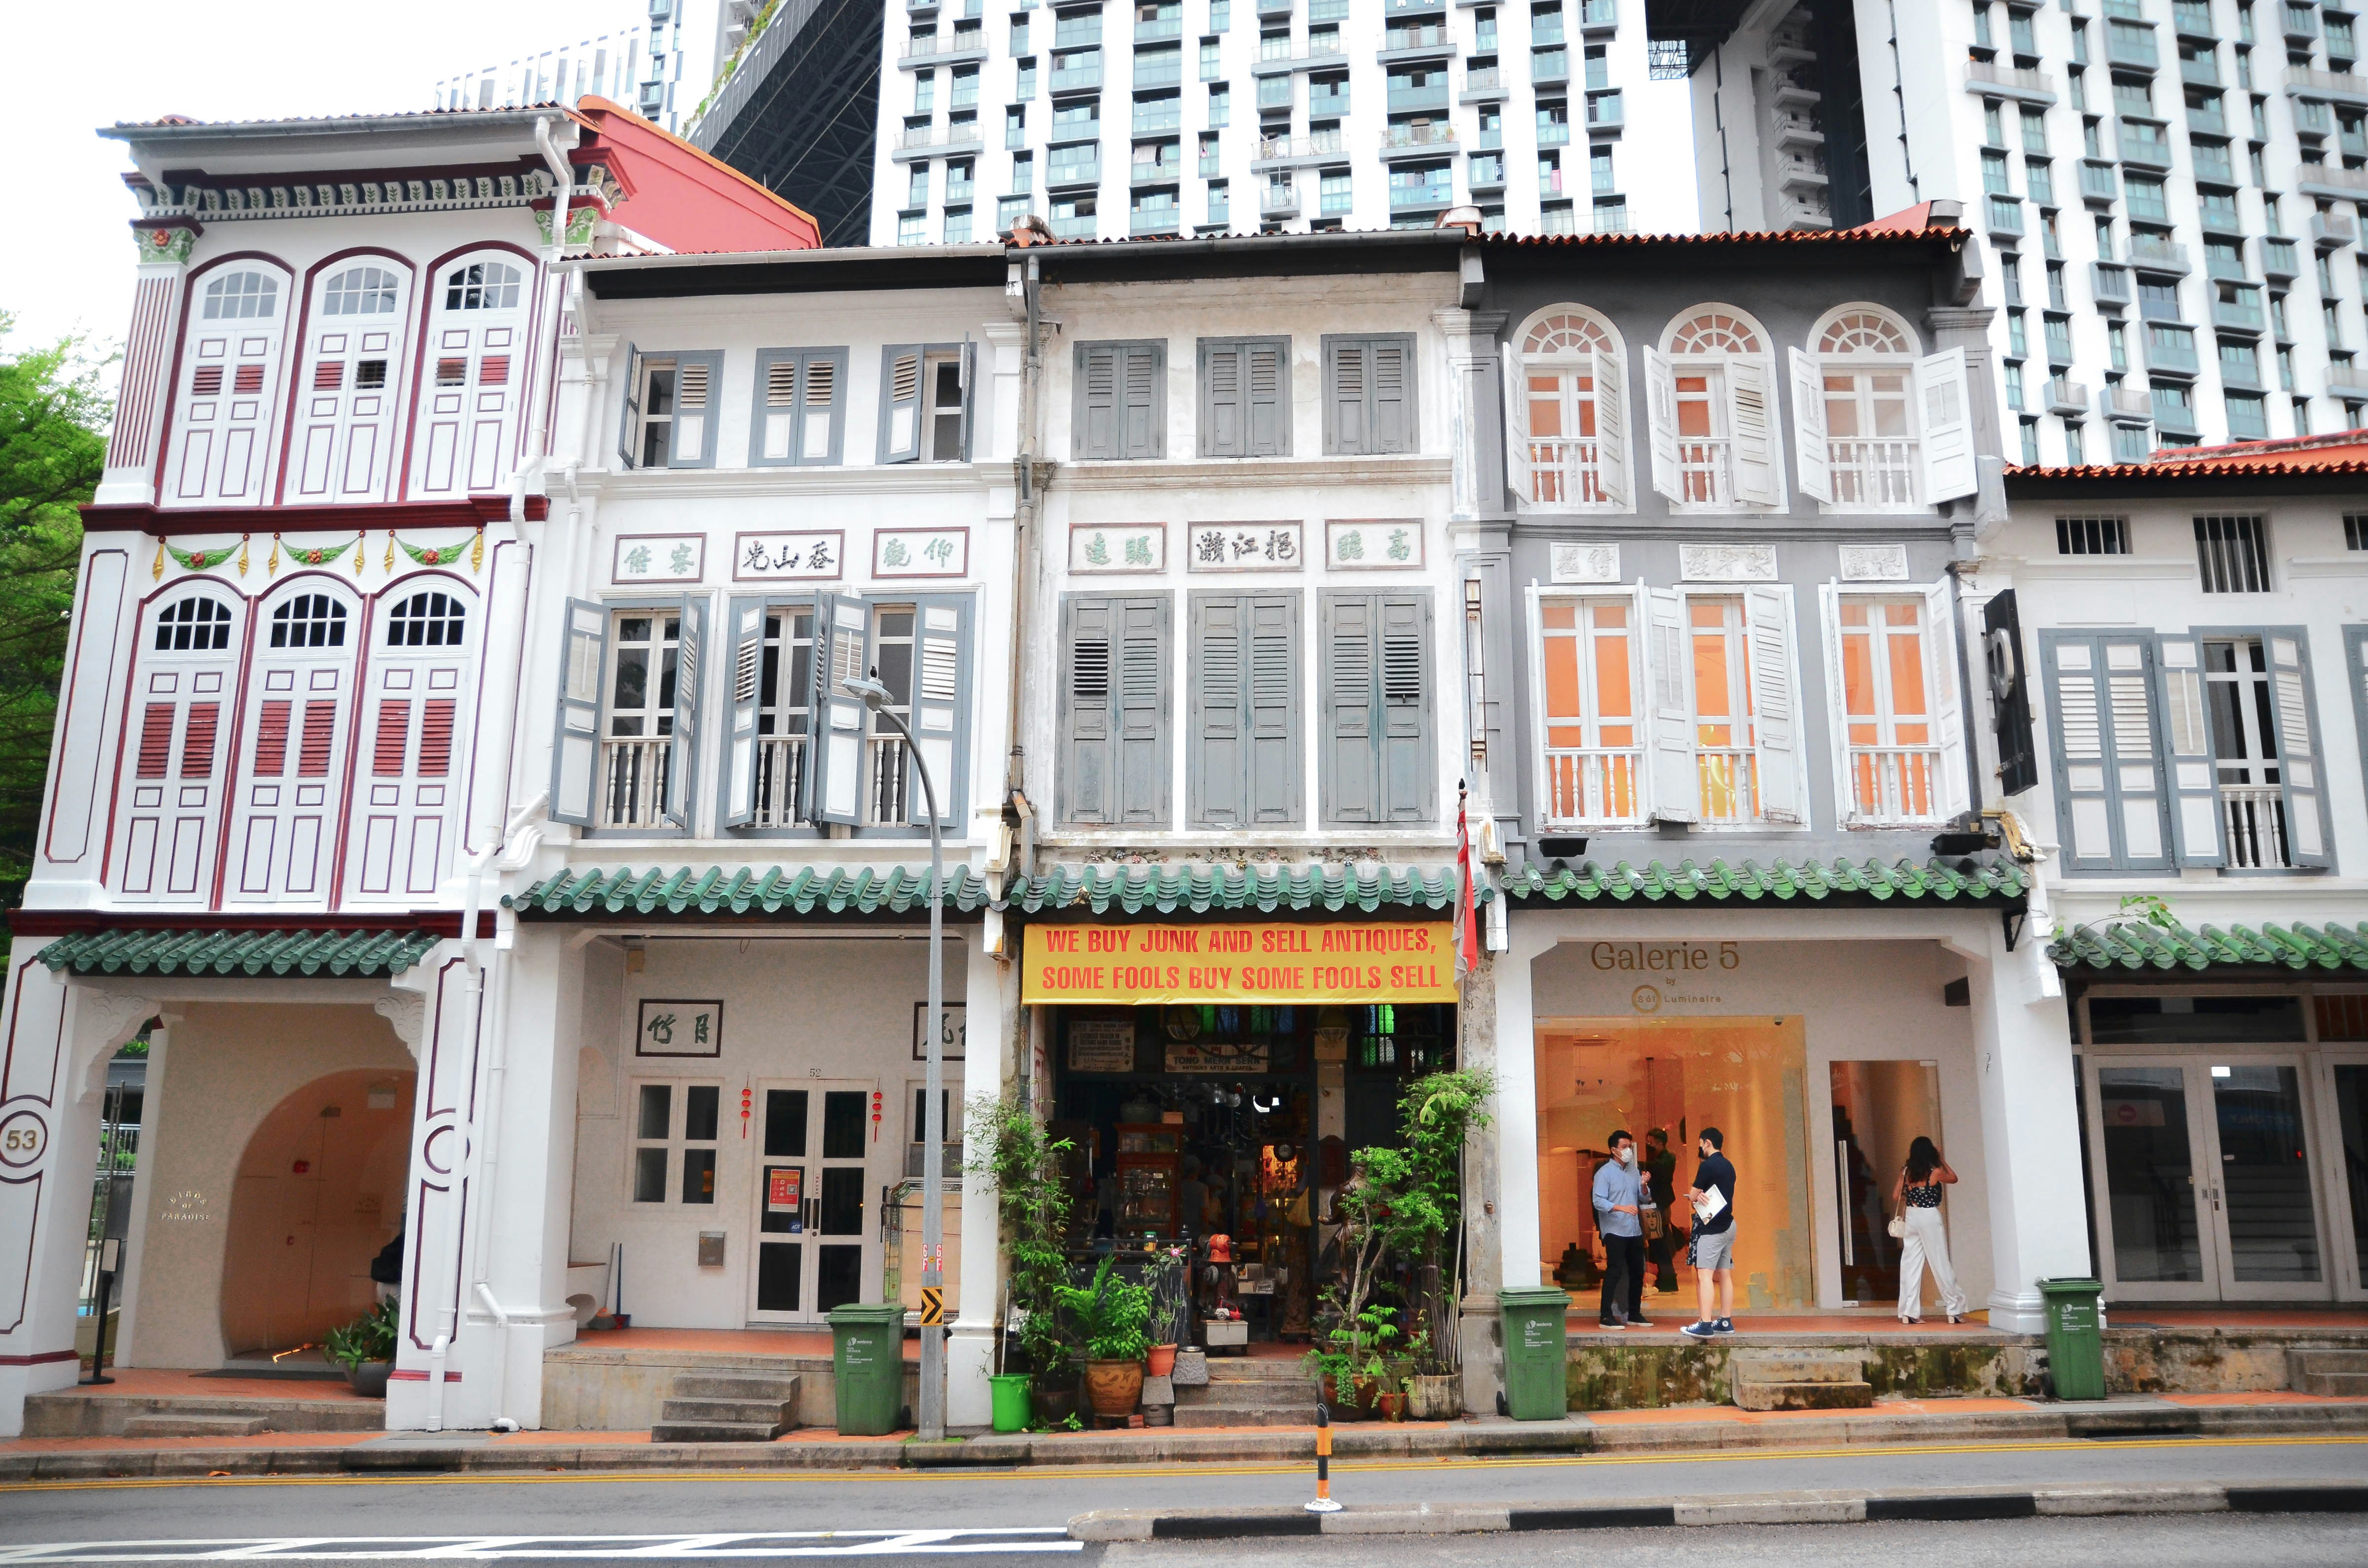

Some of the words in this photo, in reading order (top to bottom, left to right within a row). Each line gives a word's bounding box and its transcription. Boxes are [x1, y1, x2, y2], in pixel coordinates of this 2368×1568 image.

[1046, 930, 1079, 952] WE
[1088, 930, 1131, 952] BUY
[1140, 930, 1199, 952] JUNK
[1208, 931, 1253, 952] AND
[1262, 930, 1312, 952] SELL
[1321, 928, 1436, 955] ANTIQUES,
[1591, 941, 1709, 971] Galerie
[1719, 941, 1740, 970] 5
[1042, 967, 1105, 989] SOME
[1113, 967, 1180, 989] FOOLS
[1189, 967, 1232, 989] BUY
[1242, 967, 1304, 990] SOME
[1313, 966, 1381, 990] FOOLS
[1390, 965, 1442, 988] SELL
[1666, 977, 1676, 986] by
[1664, 995, 1721, 1003] Luminaire
[810, 1068, 821, 1078] 52
[6, 1130, 38, 1150] 53
[169, 1190, 207, 1204] BIRDS
[160, 1212, 211, 1222] PARADISE
